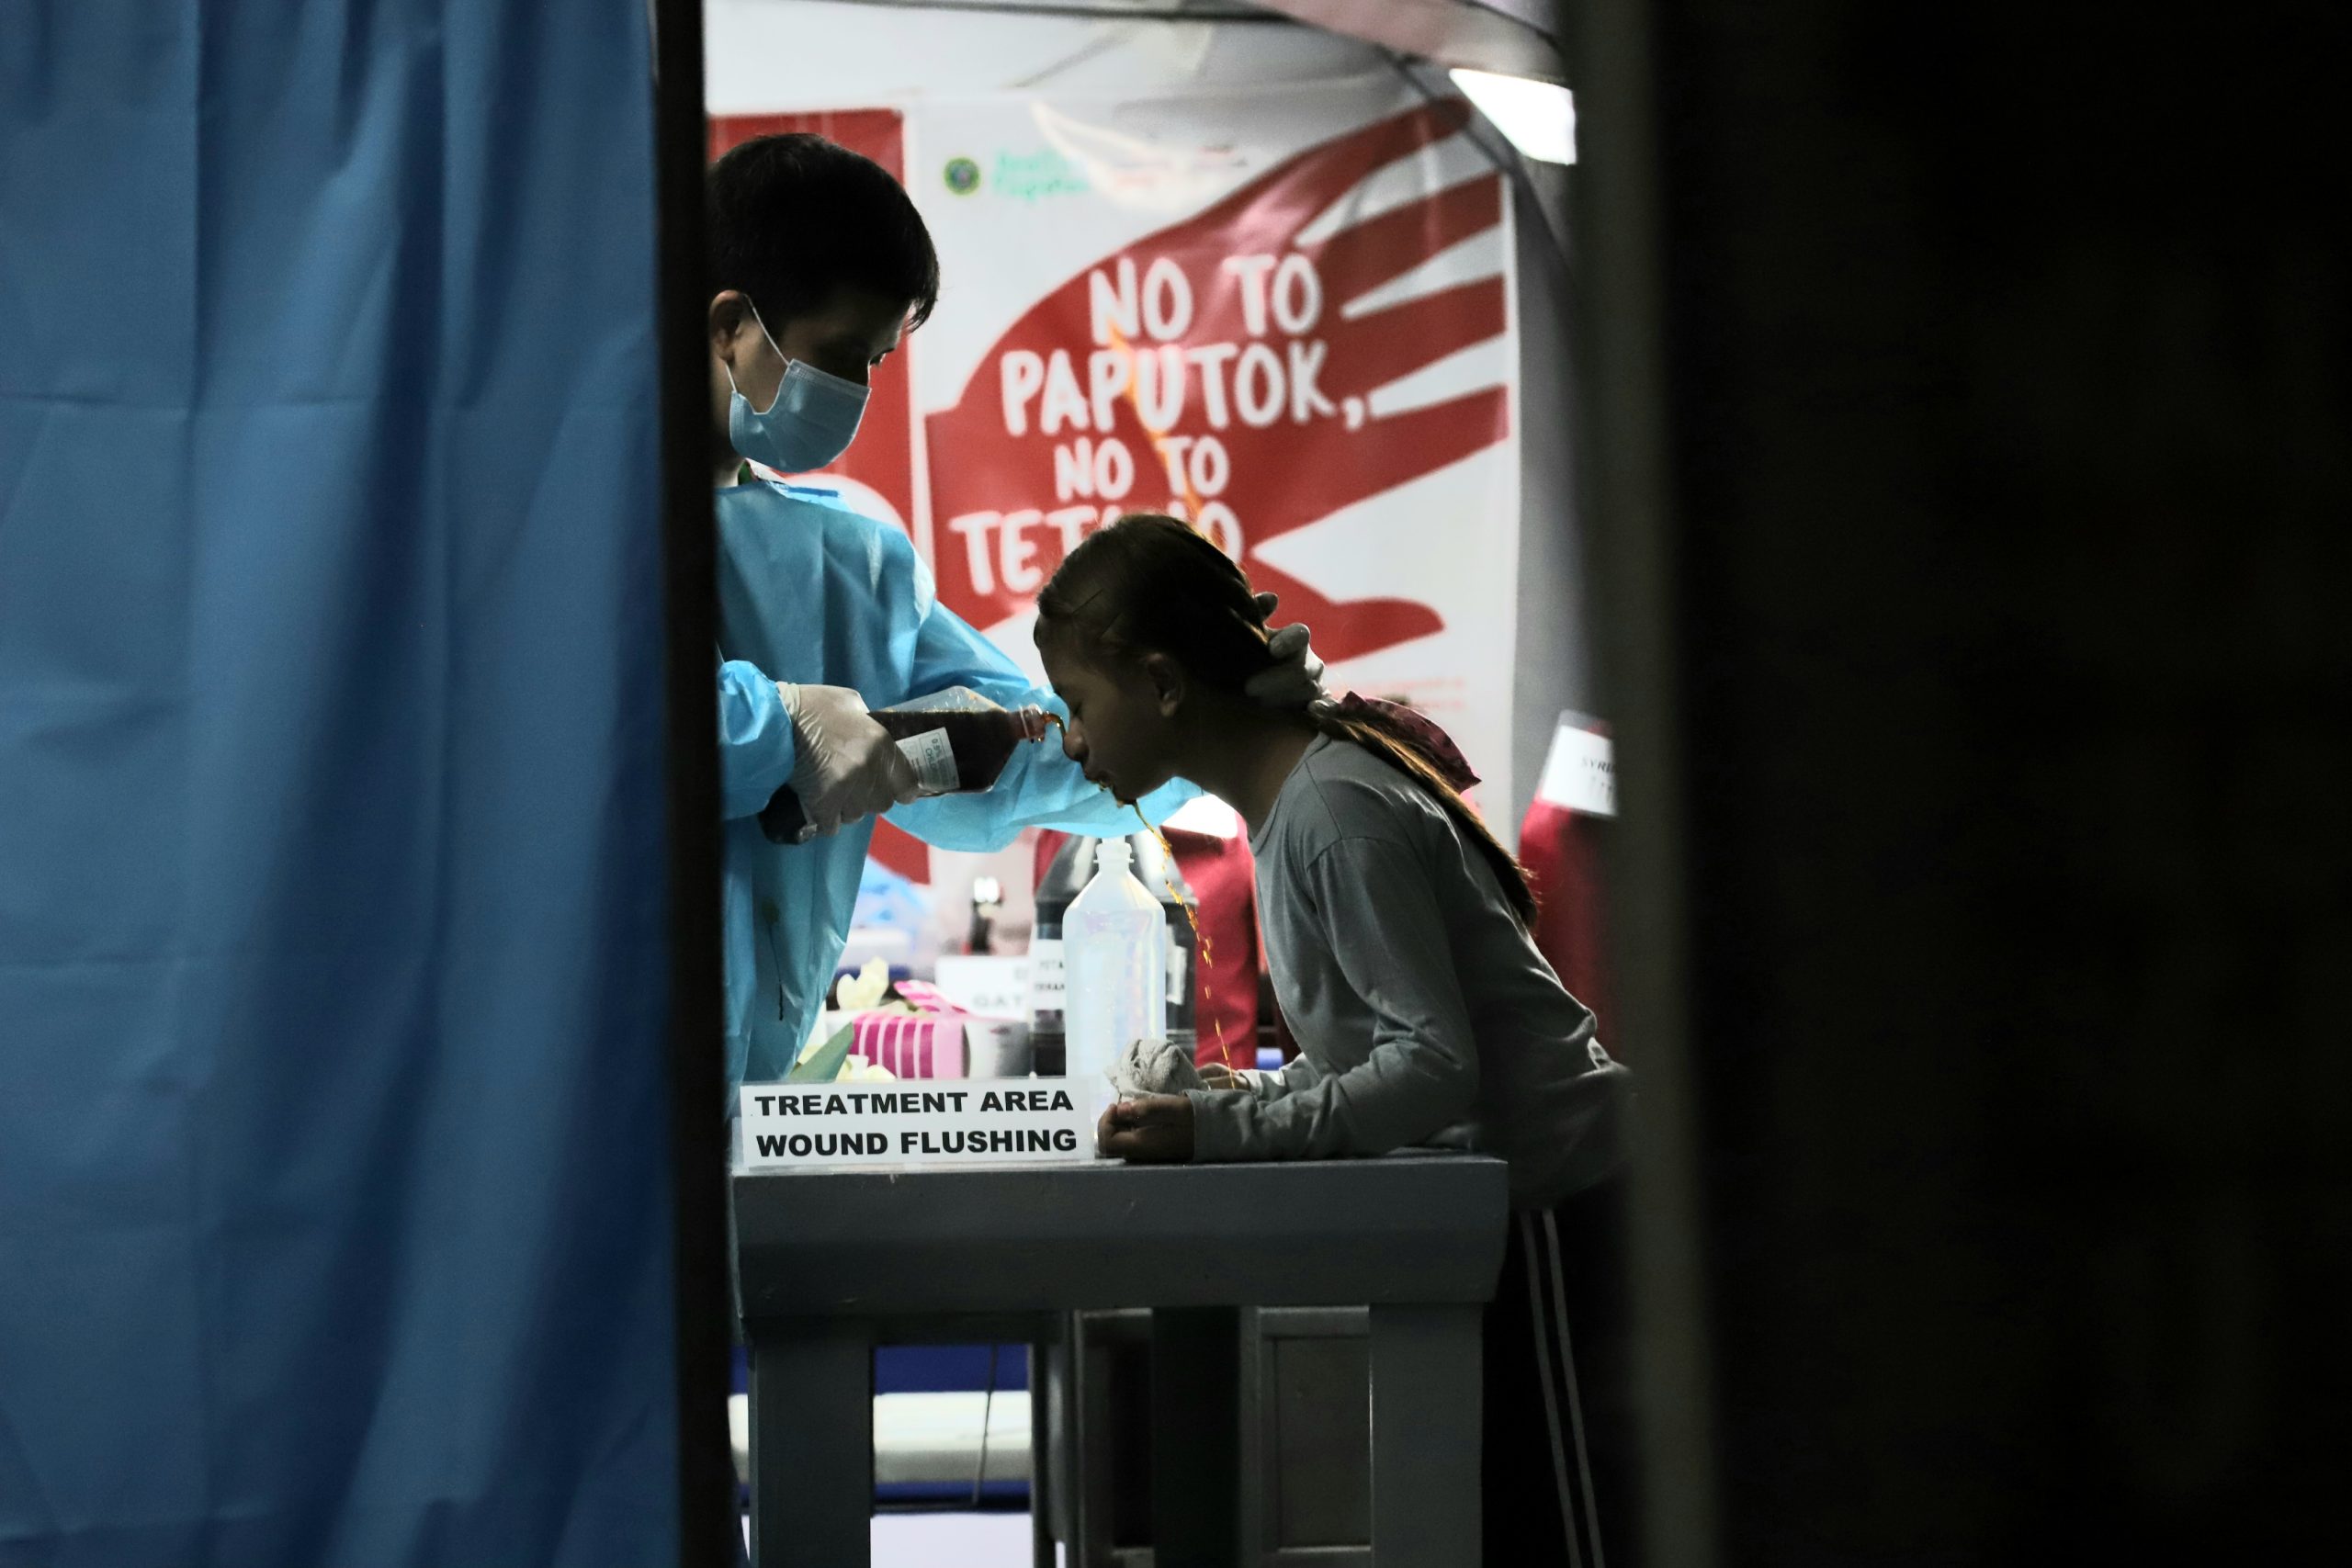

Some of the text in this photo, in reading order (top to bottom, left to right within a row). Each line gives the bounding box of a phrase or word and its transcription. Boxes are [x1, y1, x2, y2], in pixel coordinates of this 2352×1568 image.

[1091, 254, 1321, 344] NO TO
[1001, 340, 1365, 435] PAPUTOK,
[1054, 435, 1229, 501] NO TO
[949, 502, 1243, 594] TETO
[755, 1090, 1074, 1116] TREATMENT AREA
[756, 1129, 1077, 1157] WOUND FLUSHING
